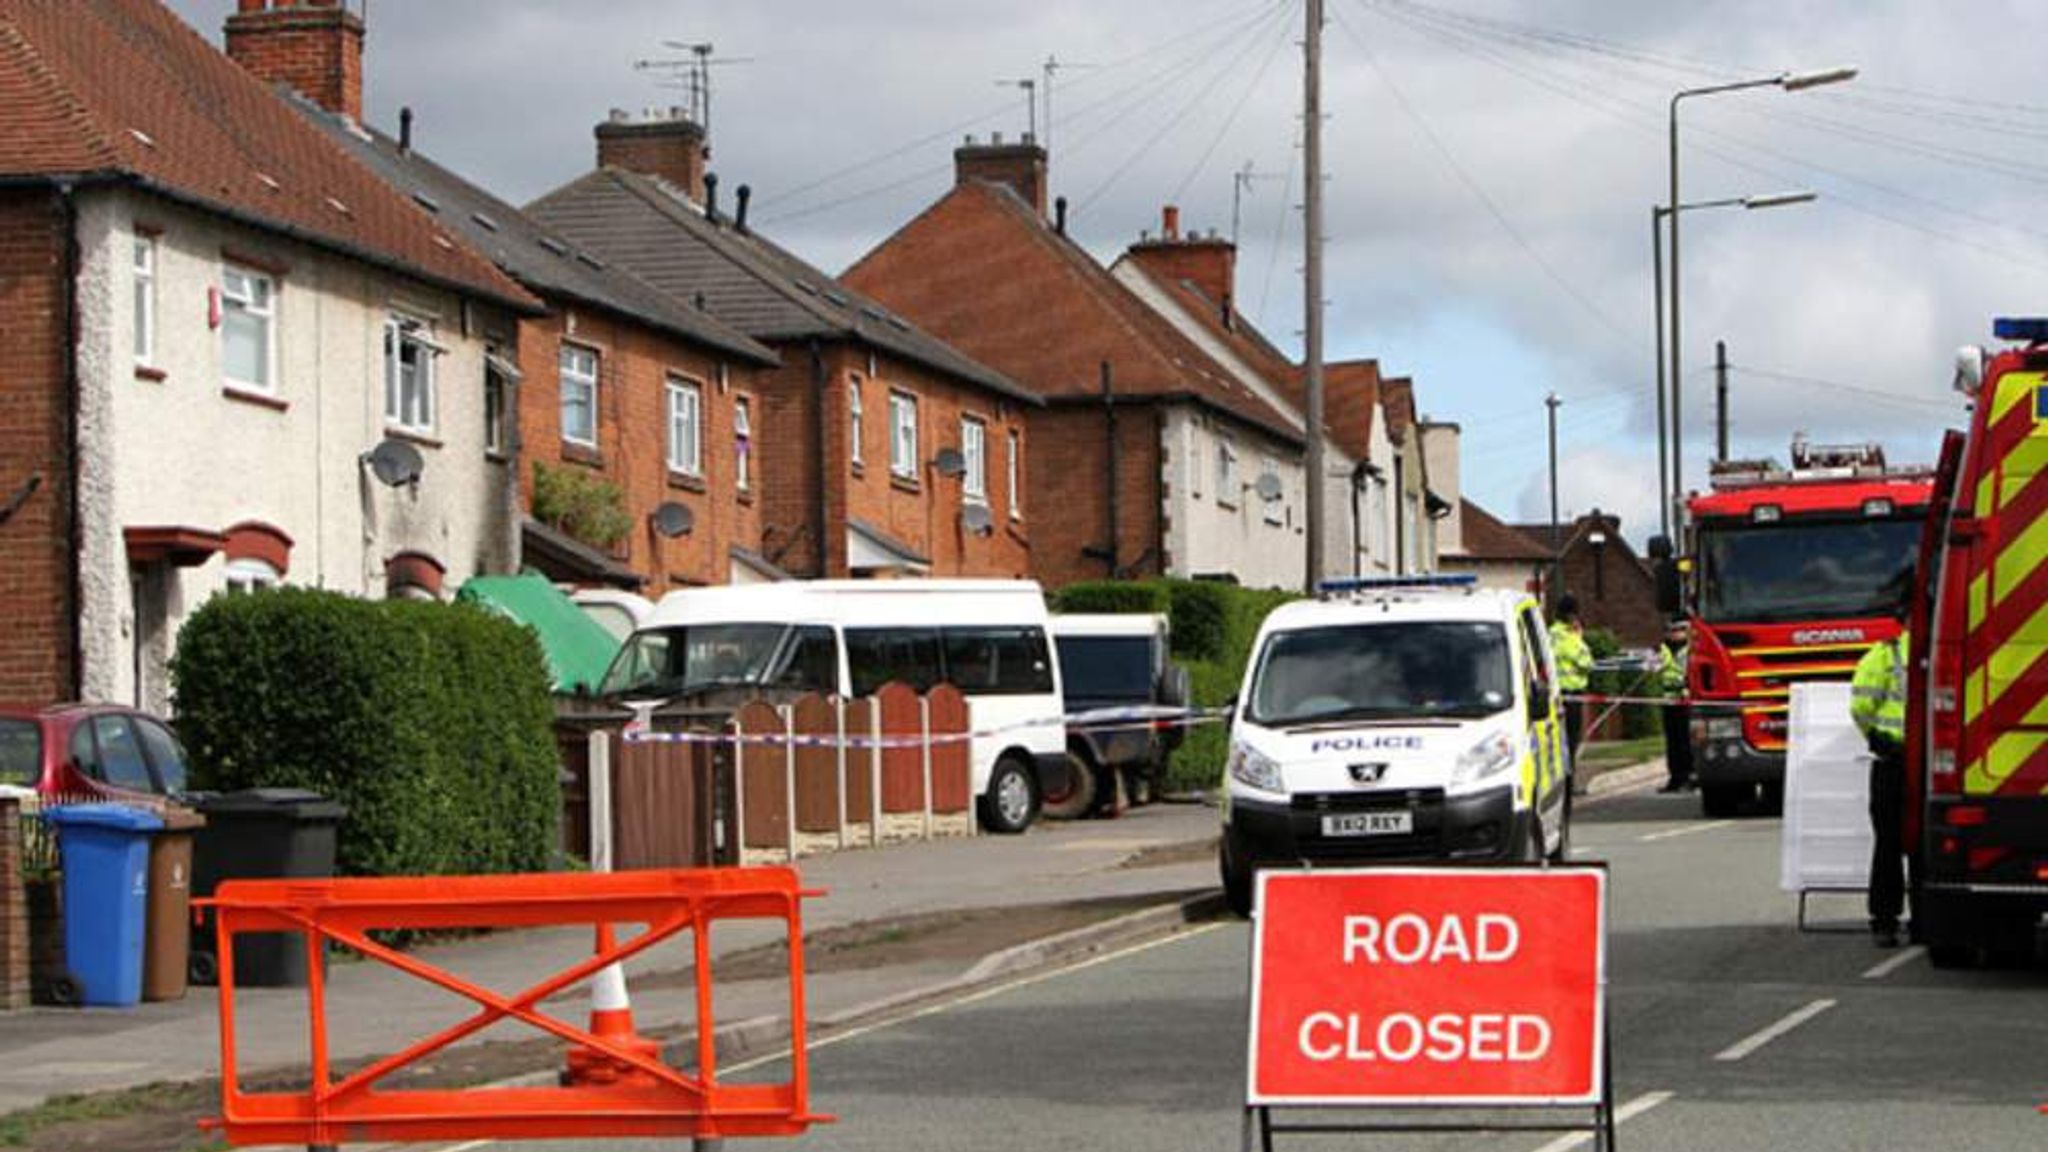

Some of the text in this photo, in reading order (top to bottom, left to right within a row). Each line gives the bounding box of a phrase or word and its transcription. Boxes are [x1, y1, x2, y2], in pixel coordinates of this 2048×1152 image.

[1793, 628, 1863, 644] SCANIA
[1311, 735, 1423, 752] POLICE
[1343, 914, 1519, 963] ROAD
[1299, 1011, 1551, 1061] CLOSED
